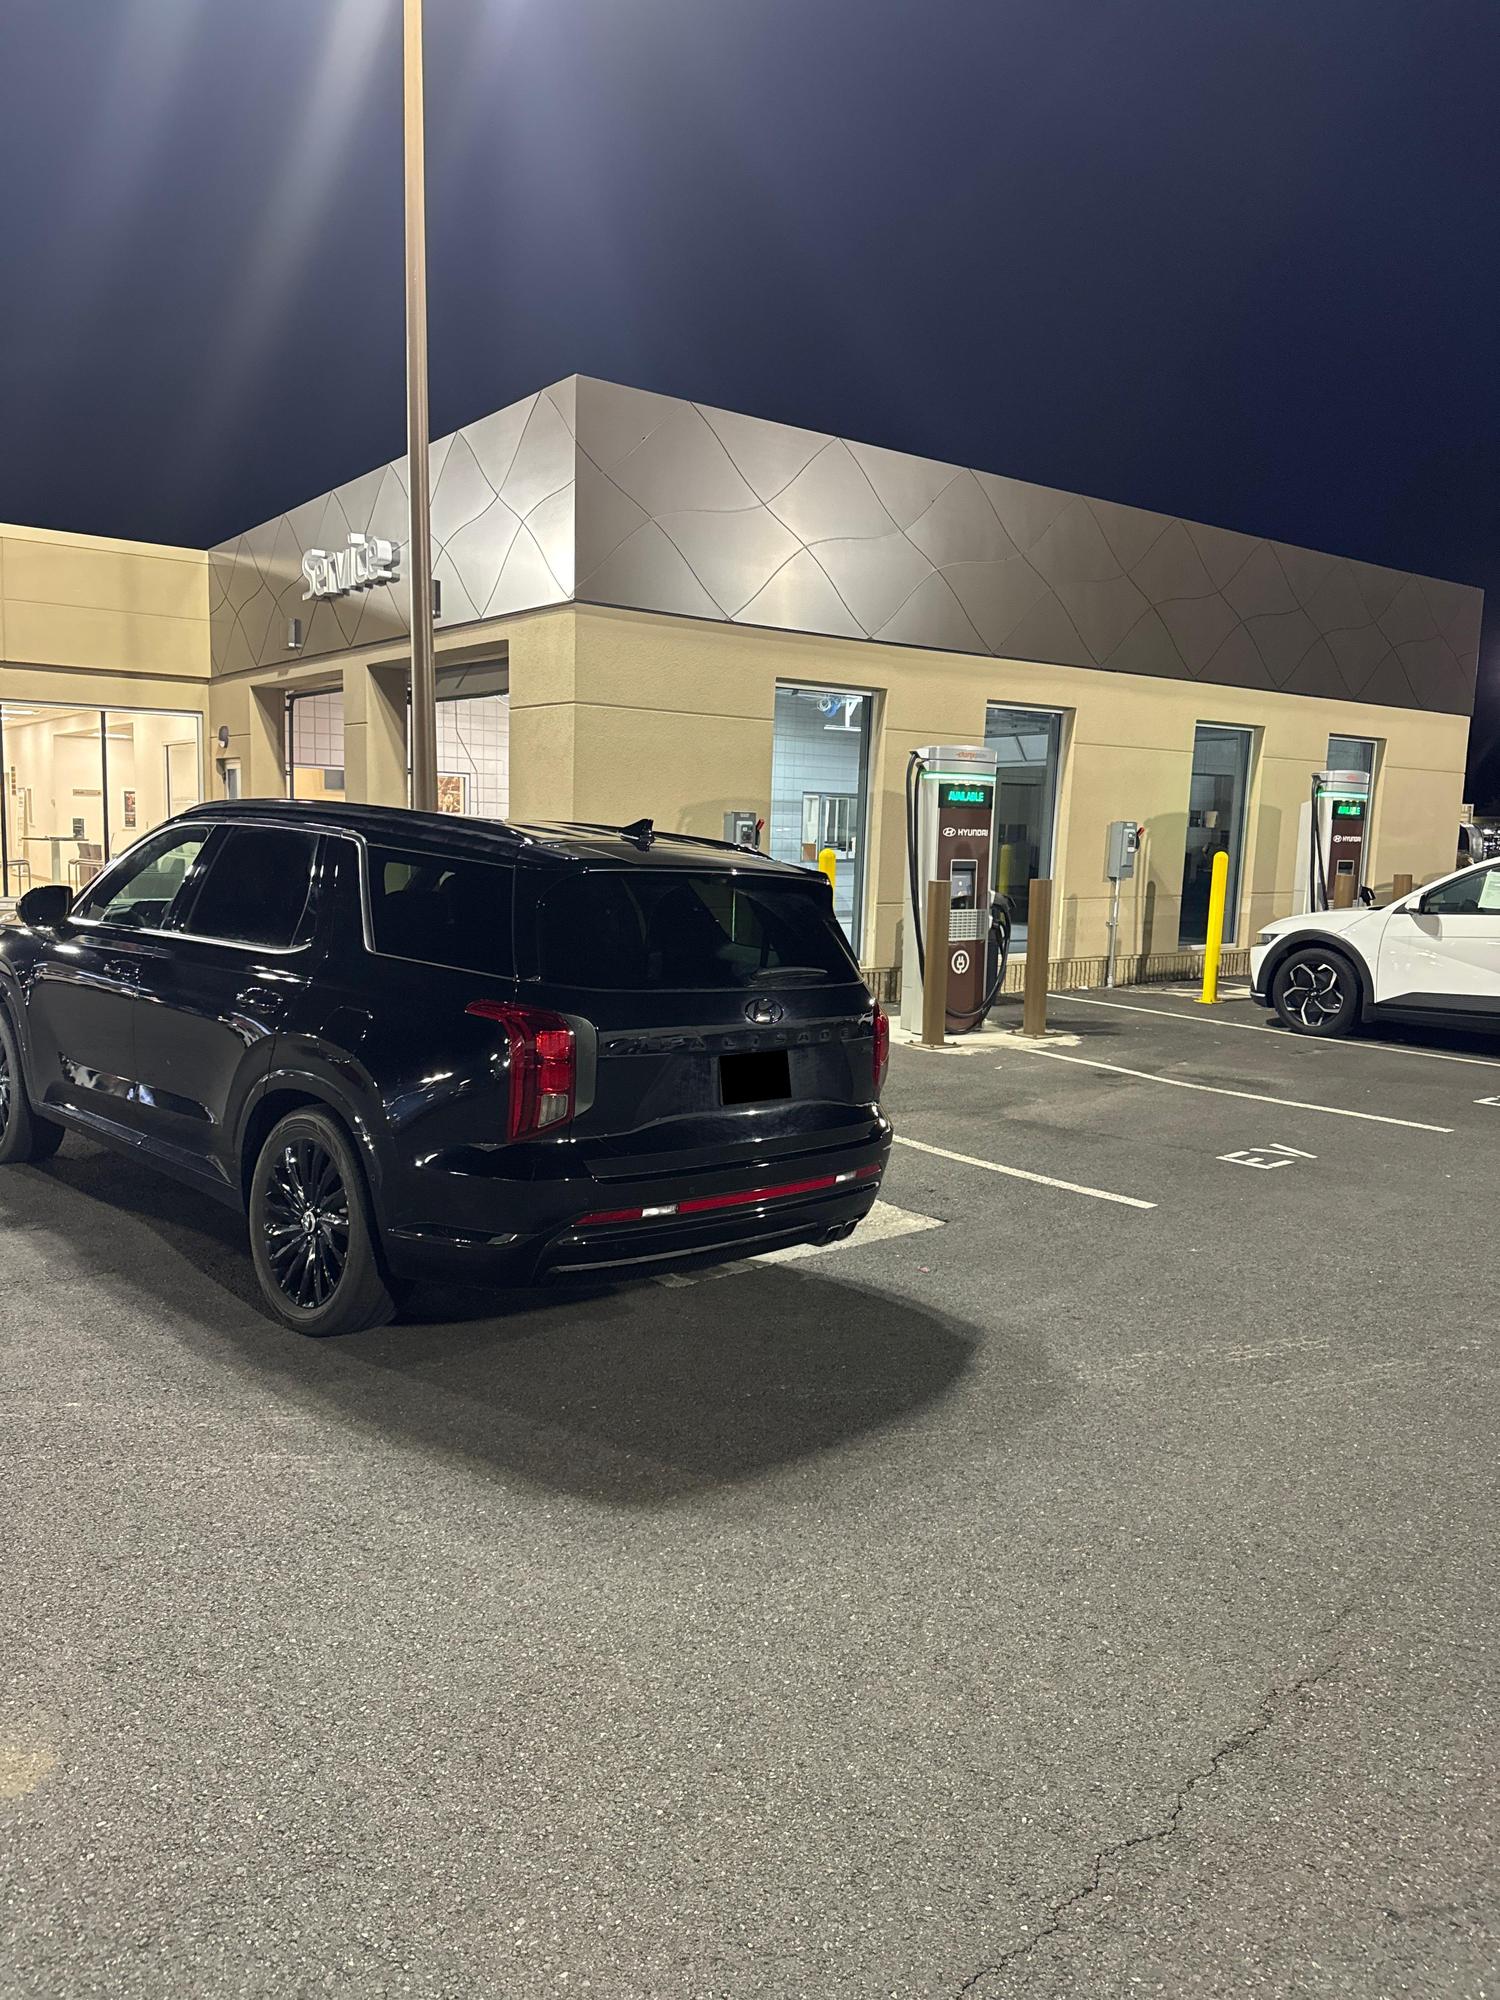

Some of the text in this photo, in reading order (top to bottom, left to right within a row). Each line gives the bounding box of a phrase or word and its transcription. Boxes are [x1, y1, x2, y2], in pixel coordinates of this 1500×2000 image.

[302, 533, 400, 601] Service
[948, 790, 984, 802] AVAILABLE
[957, 828, 989, 837] HYUNDAI
[671, 1027, 849, 1051] PALISADE
[1215, 1142, 1318, 1170] EV
